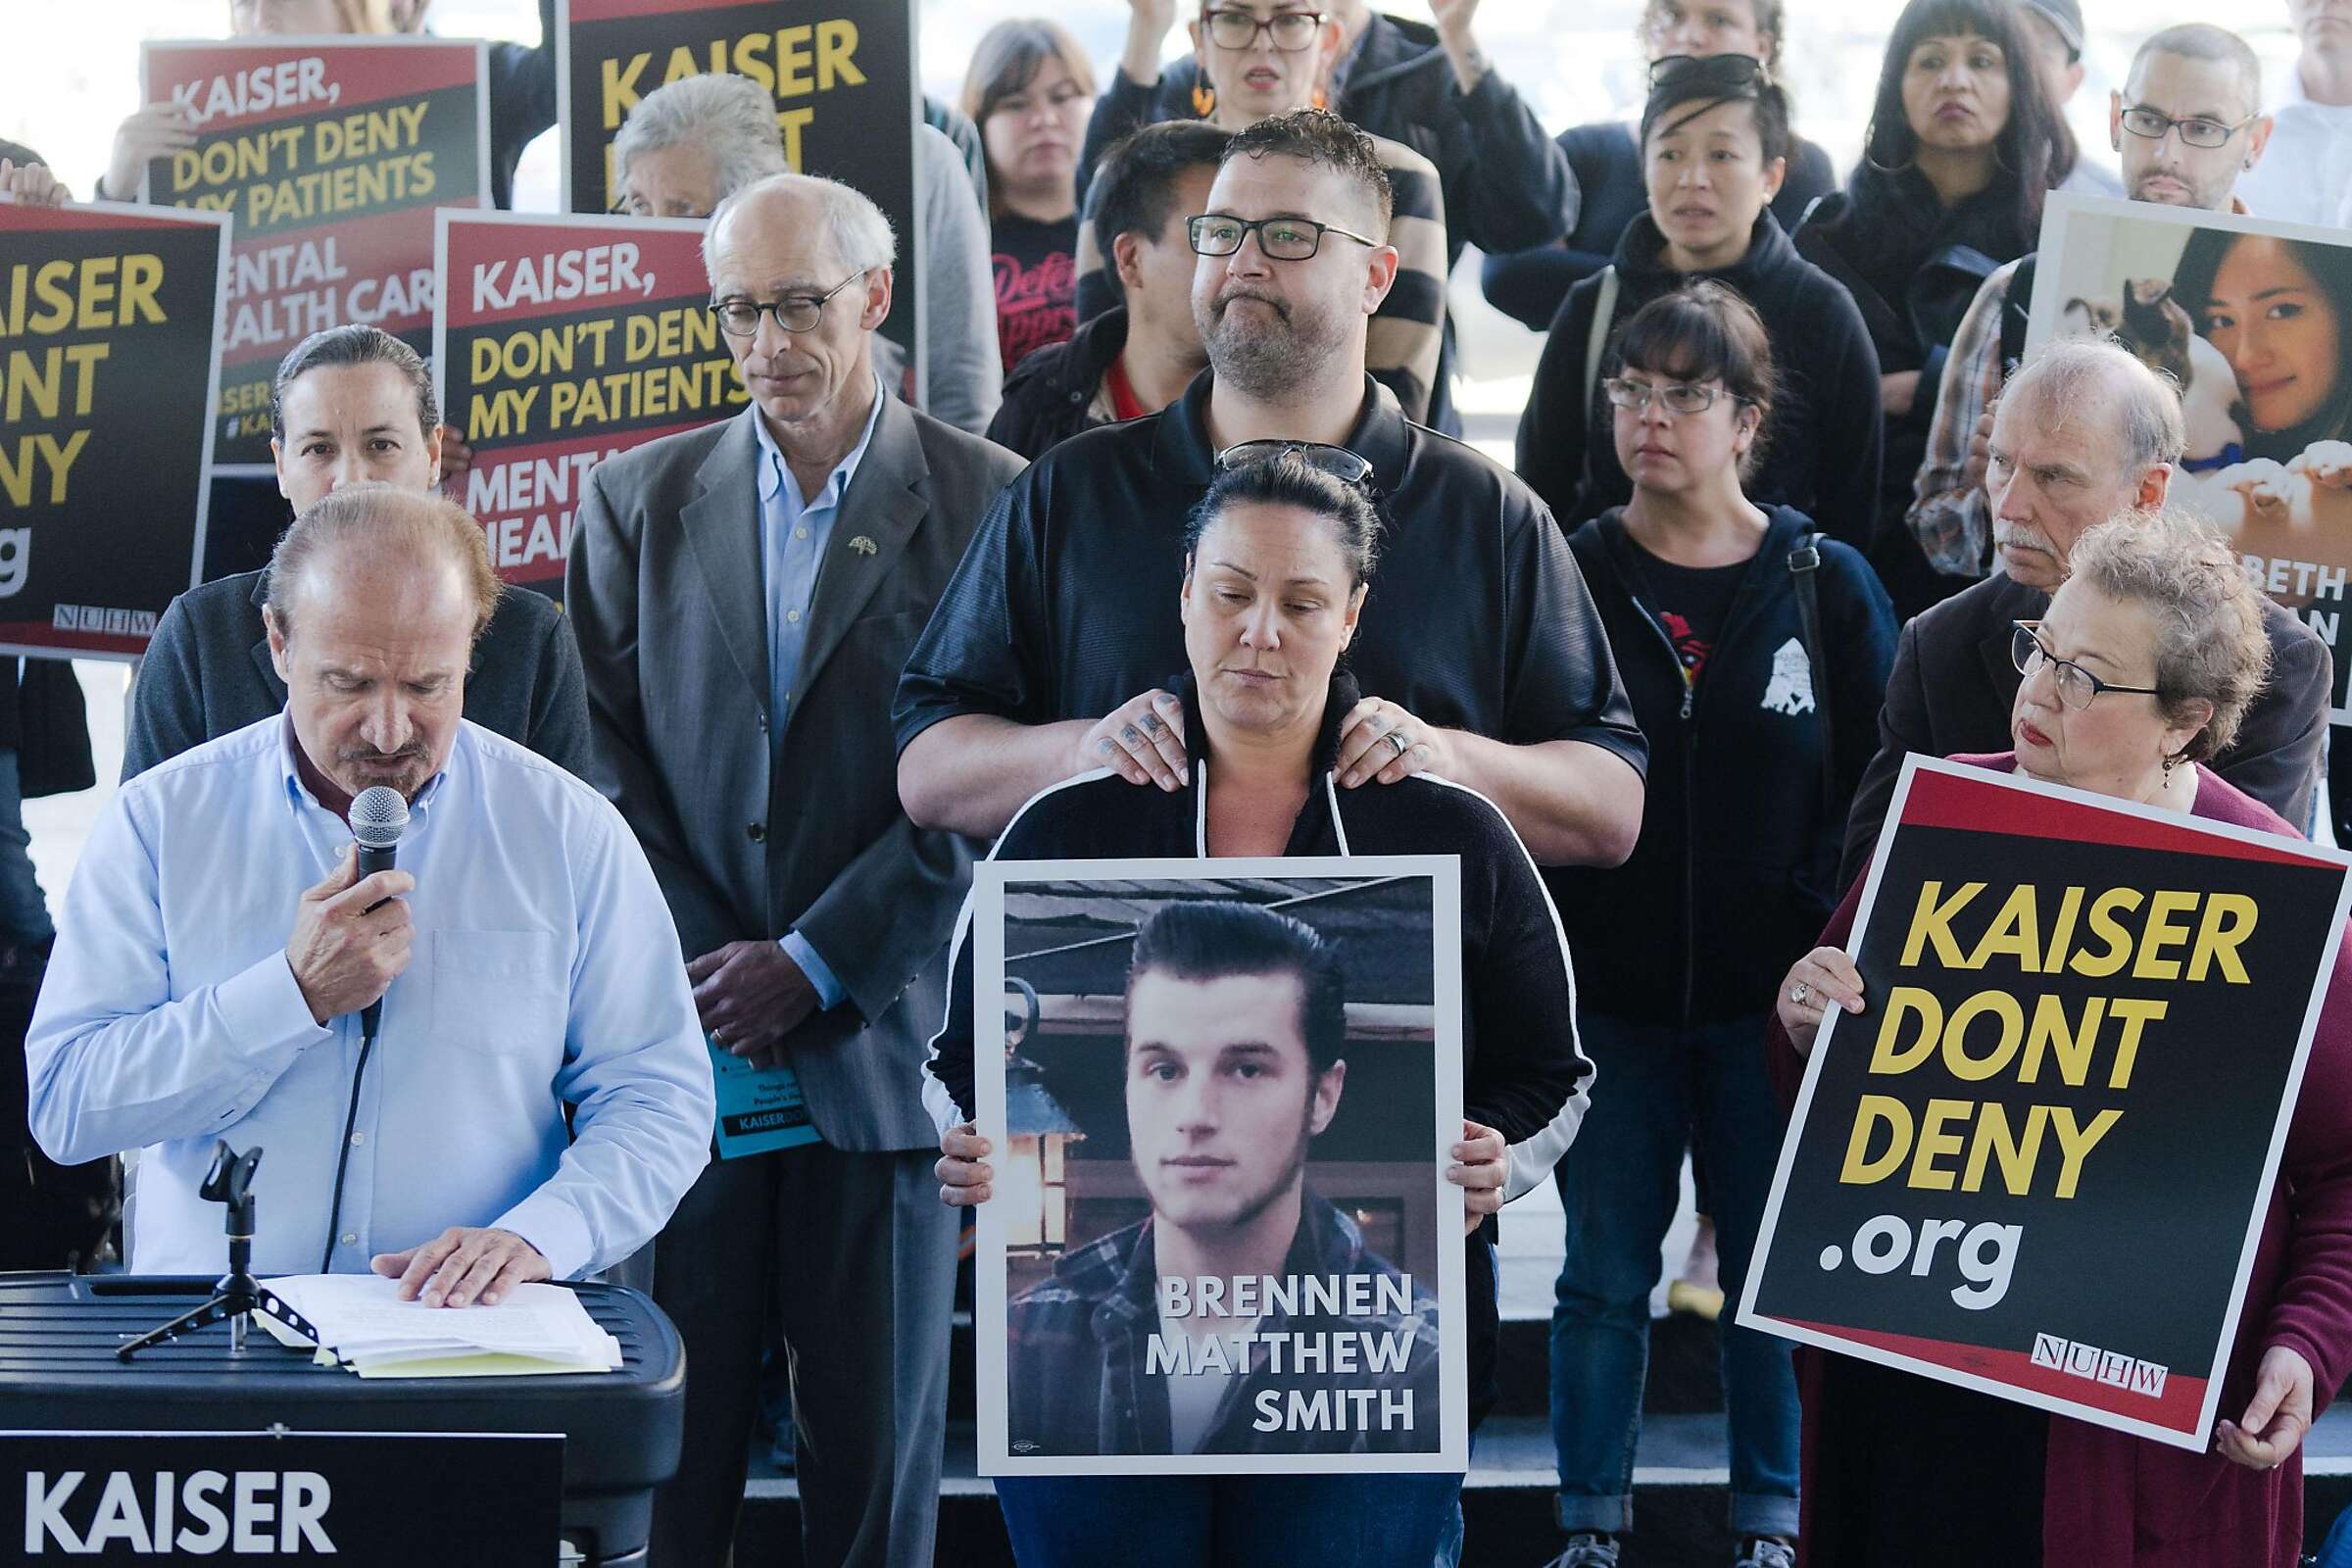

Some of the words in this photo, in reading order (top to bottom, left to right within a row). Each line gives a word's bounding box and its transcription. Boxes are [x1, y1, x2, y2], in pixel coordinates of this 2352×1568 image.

[172, 57, 340, 126] KAISER,
[172, 125, 306, 192] DON'T
[314, 102, 429, 165] DENY
[248, 151, 437, 227] PATIENTS
[0, 253, 168, 337] ISER
[472, 242, 656, 313] KAISER,
[223, 286, 335, 351] ALTH
[470, 318, 614, 386] DON'T
[468, 386, 539, 441] MY
[550, 359, 751, 430] PATIENTS
[466, 448, 619, 514] MENT
[53, 604, 157, 635] NUHW
[1899, 880, 2259, 984] KAISER
[1868, 986, 2169, 1089] DONT
[1838, 1094, 2124, 1200] DENY
[1160, 1274, 1413, 1318] BRENNEN
[1818, 1213, 2024, 1310] .org
[1144, 1331, 1414, 1376] MATTHEW
[2032, 1333, 2168, 1397] NUHW
[1251, 1388, 1414, 1433] SMITH
[24, 1470, 338, 1554] KAISER
